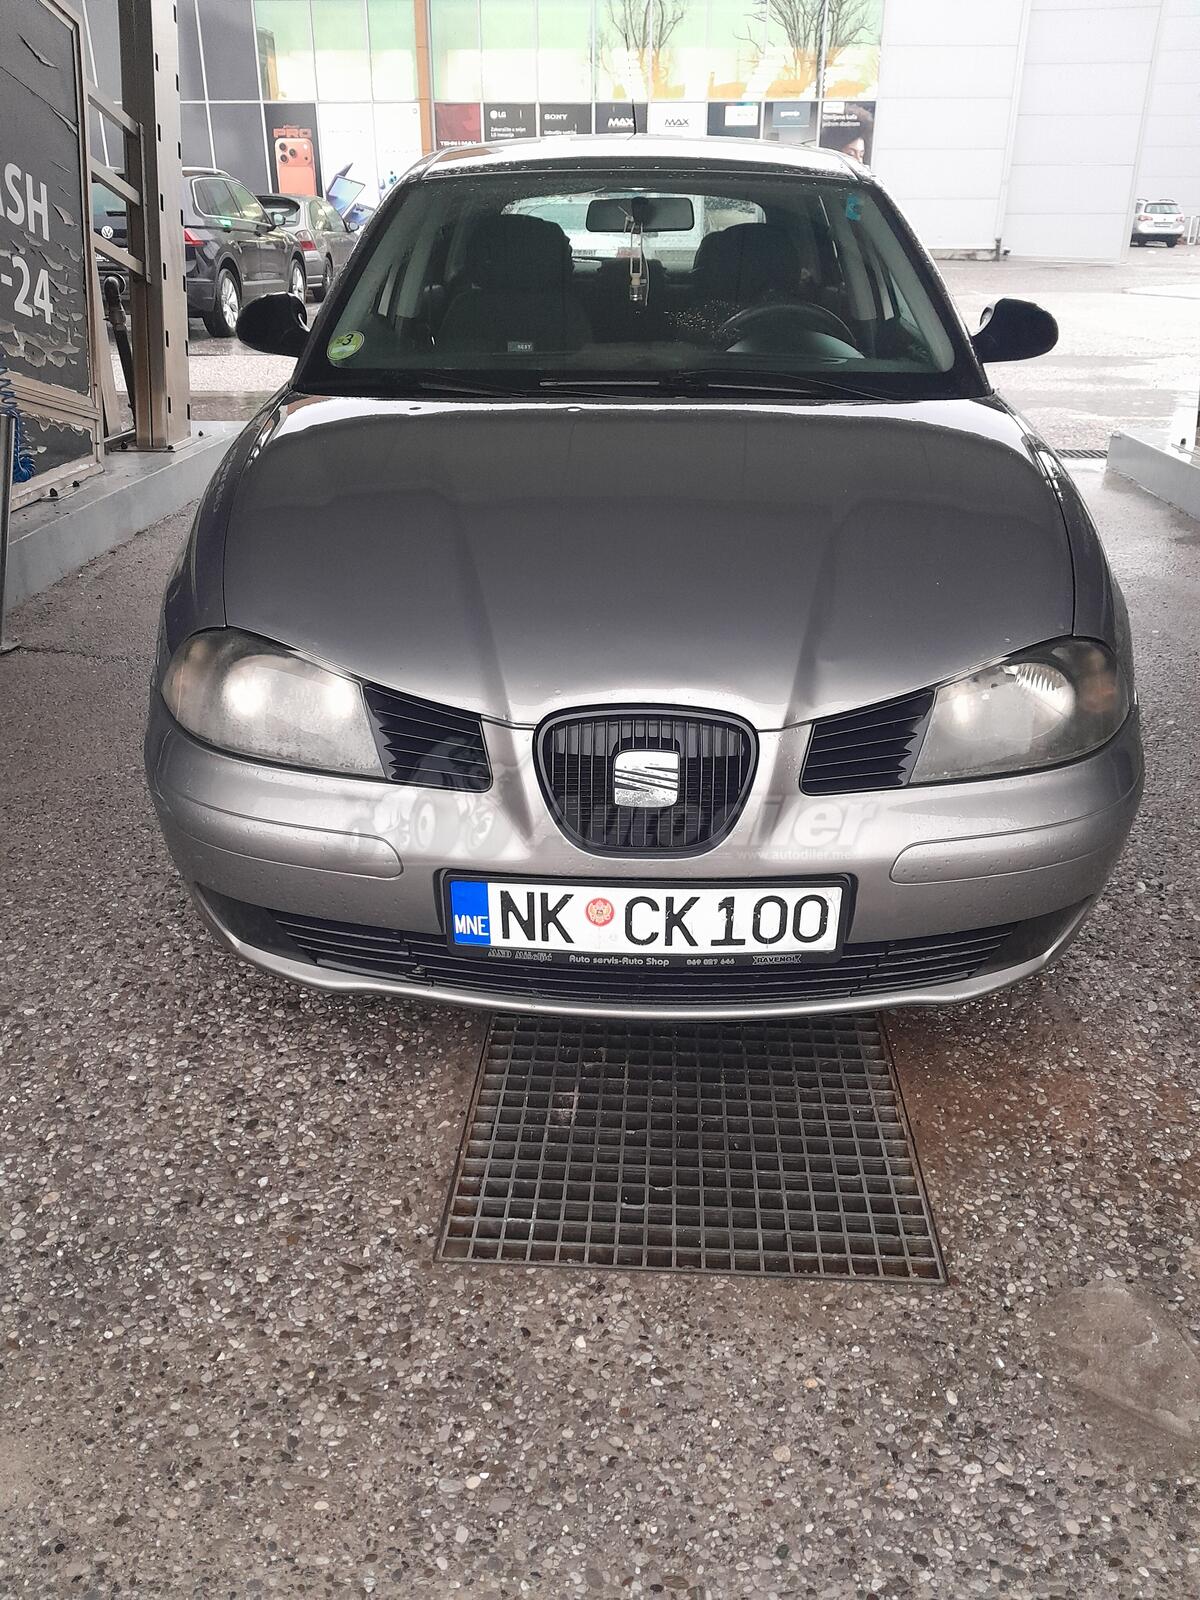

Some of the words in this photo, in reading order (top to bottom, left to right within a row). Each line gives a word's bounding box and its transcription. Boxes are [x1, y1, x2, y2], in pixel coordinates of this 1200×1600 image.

[607, 117, 636, 128] MAX
[664, 118, 689, 128] MAX
[273, 128, 312, 138] PRO
[0, 162, 50, 242] SH
[342, 333, 354, 346] 3
[500, 890, 575, 944] NK
[454, 914, 489, 937] MNE
[569, 954, 590, 964] Auto
[646, 957, 669, 967] Shop
[752, 954, 801, 965] RAVENOL
